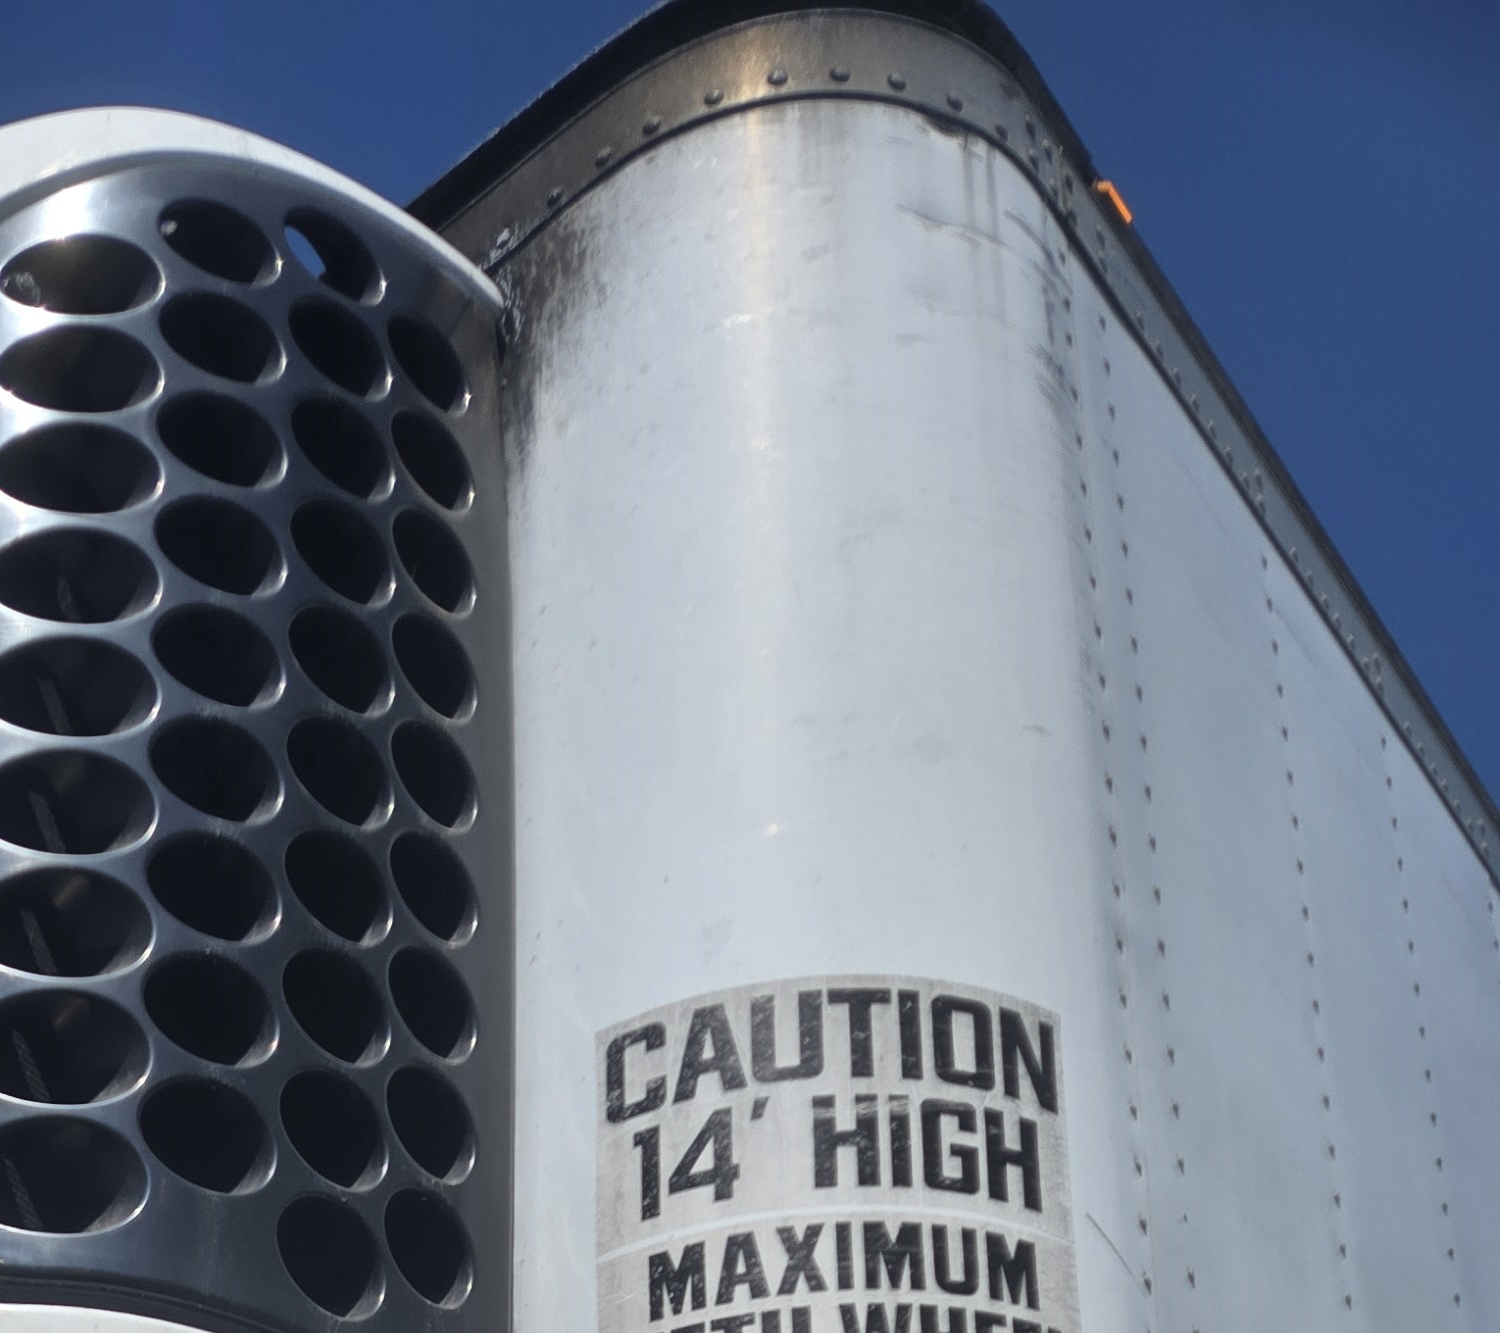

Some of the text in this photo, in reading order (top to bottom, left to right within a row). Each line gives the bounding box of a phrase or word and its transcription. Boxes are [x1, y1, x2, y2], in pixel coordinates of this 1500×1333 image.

[605, 986, 1059, 1125] CAUTION
[633, 1092, 1043, 1222] 14' HIGH
[648, 1220, 1040, 1322] MAXIMUM
